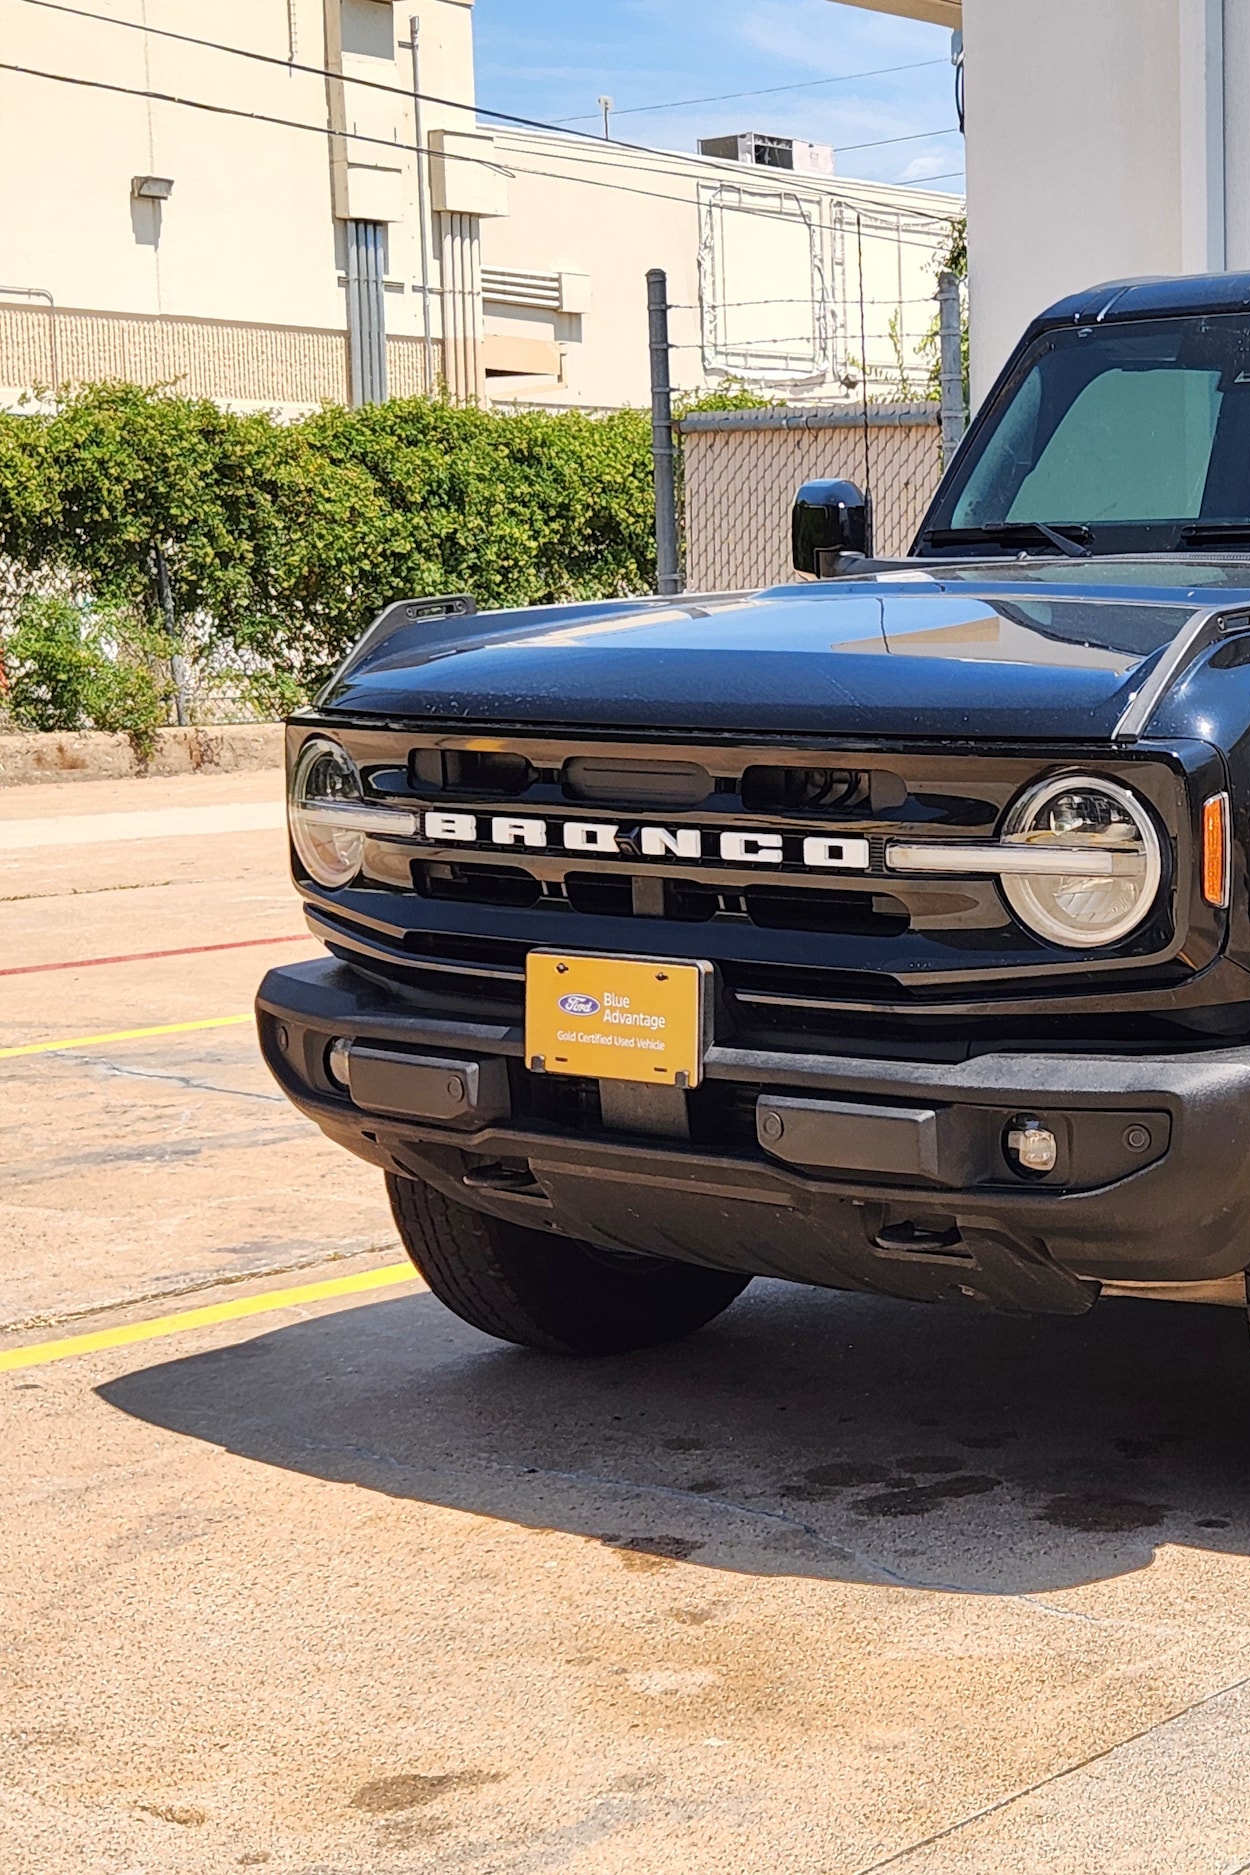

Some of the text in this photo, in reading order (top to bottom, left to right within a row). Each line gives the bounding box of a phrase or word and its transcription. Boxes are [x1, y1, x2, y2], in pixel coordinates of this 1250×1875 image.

[424, 811, 870, 869] BRONCO
[603, 992, 630, 1008] Blue
[603, 1009, 666, 1030] Advantage
[557, 1030, 665, 1050] Gold Certified Used Vehicle
